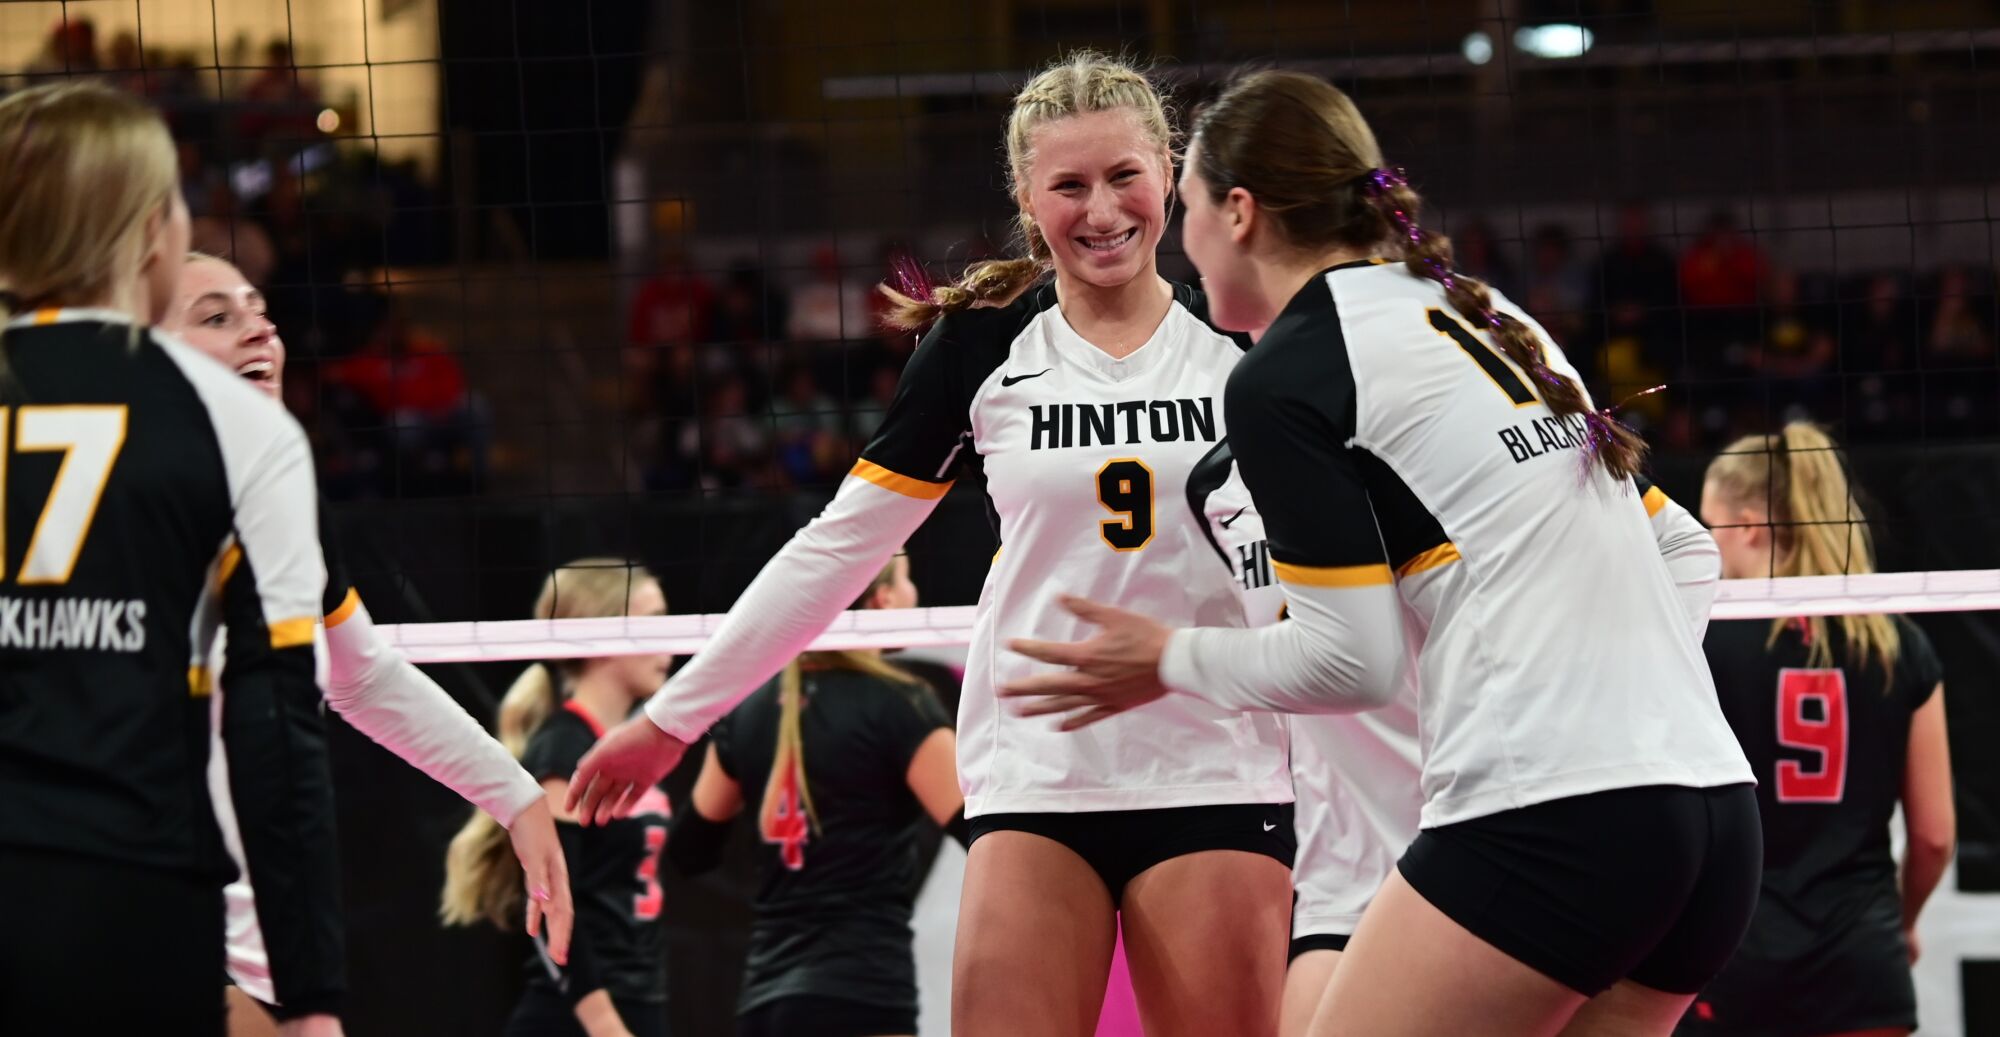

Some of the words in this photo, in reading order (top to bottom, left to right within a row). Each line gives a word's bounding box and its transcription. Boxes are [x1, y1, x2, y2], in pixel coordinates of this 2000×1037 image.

[1425, 306, 1551, 409] 1
[1029, 397, 1217, 450] HINTON
[1497, 415, 1589, 464] BLACKH
[0, 404, 129, 585] 7
[1096, 458, 1156, 551] 9
[1237, 540, 1279, 590] HI
[0, 596, 147, 652] KHAWKS
[1776, 667, 1848, 803] 9
[760, 755, 809, 870] 4
[634, 825, 667, 921] 3
